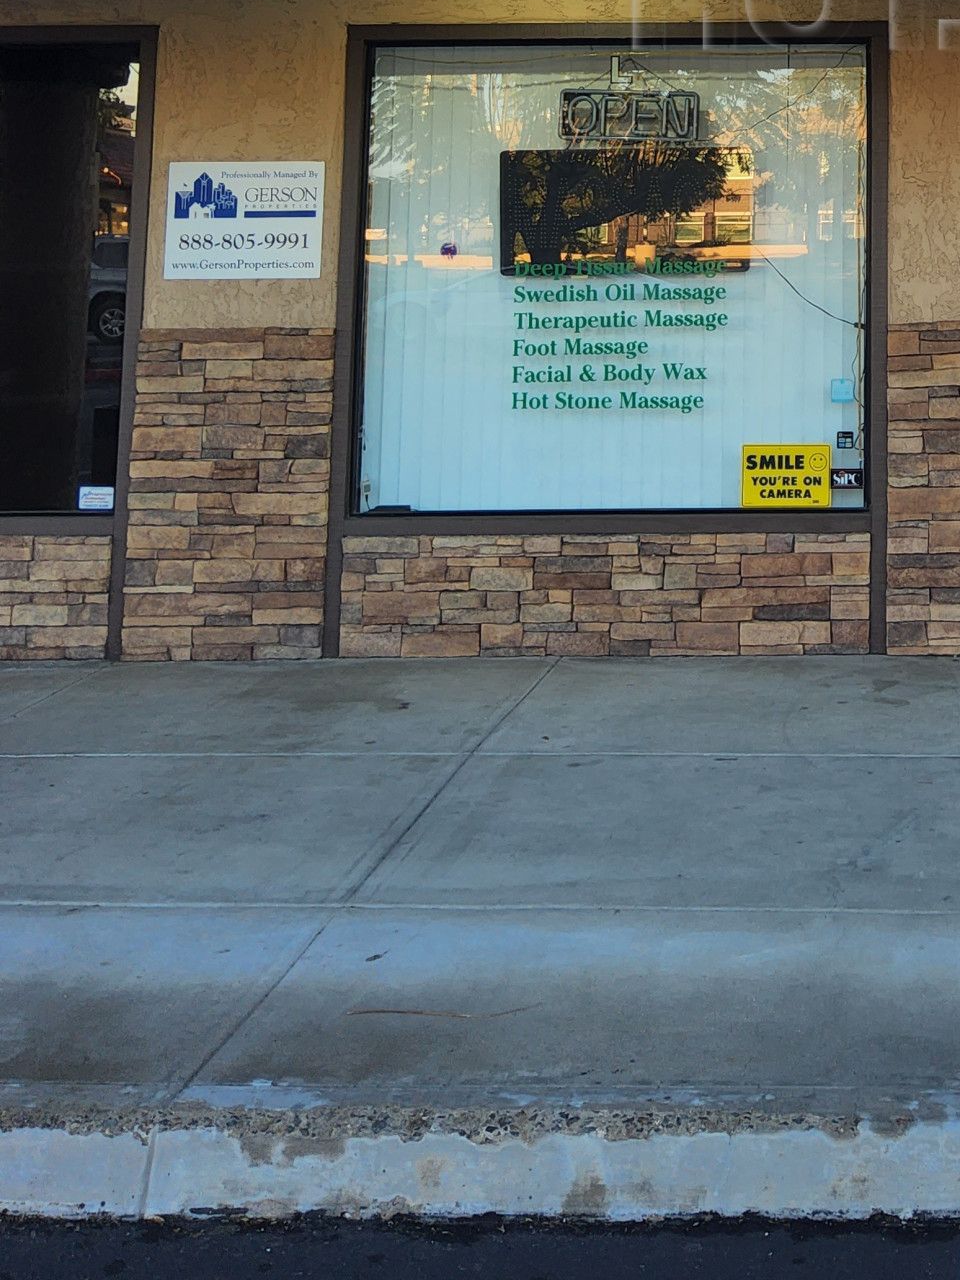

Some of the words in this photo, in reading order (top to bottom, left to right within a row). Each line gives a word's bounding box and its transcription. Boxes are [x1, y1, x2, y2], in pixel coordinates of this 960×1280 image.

[567, 95, 691, 138] OPEN
[221, 171, 271, 181] Professionally
[273, 171, 306, 180] Managed
[308, 170, 319, 179] By
[245, 187, 318, 203] GERSON
[178, 233, 309, 251] 888-805-9991
[172, 259, 315, 272] www.GersonProperties.com
[514, 259, 567, 280] Deep
[576, 257, 636, 277] Tissue
[645, 257, 728, 278] Massage
[513, 285, 598, 303] Swedish
[605, 284, 636, 301] Oil
[643, 284, 727, 304] Massage
[514, 311, 638, 333] Therapeutic
[644, 310, 729, 331] Massage
[512, 339, 557, 357] Foot
[564, 338, 649, 359] Massage
[512, 365, 572, 384] Facial
[579, 364, 598, 382] &
[603, 364, 656, 386] Body
[662, 362, 708, 381] Wax
[511, 392, 549, 410] Hot
[554, 391, 613, 410] Stone
[619, 391, 705, 414] Massage
[745, 454, 805, 471] SMILE
[751, 476, 798, 486] YOU'RE
[803, 476, 822, 486] ON
[759, 489, 812, 499] CAMERA
